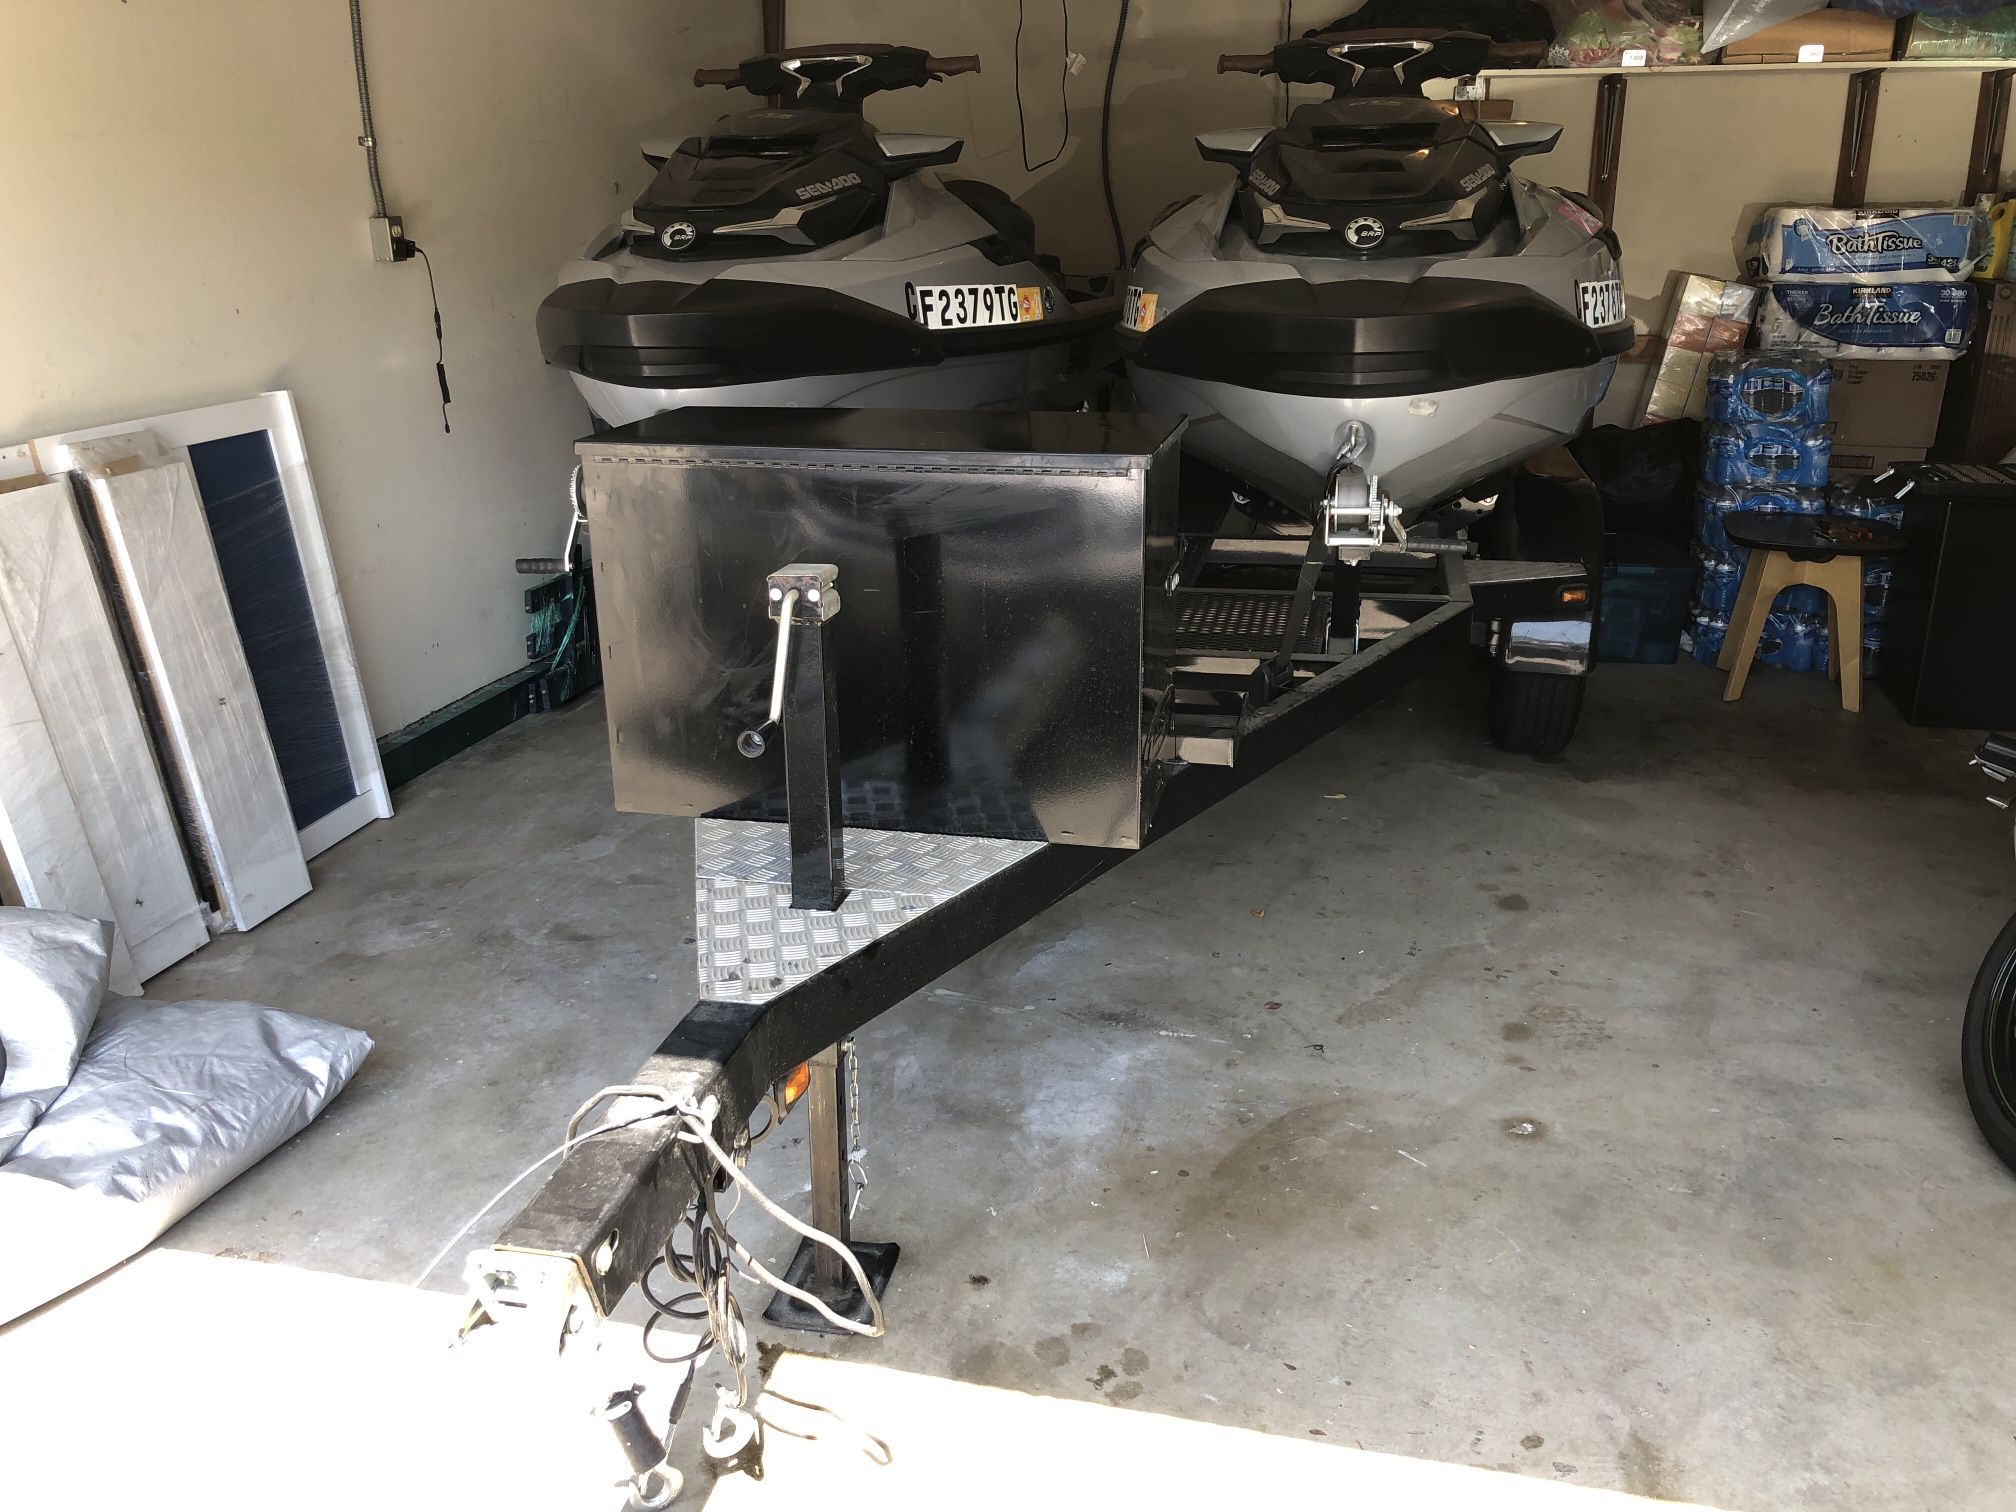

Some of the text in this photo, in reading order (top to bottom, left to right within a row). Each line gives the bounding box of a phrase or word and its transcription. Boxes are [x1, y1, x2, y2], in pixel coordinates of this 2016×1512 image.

[1828, 231, 1923, 254] Bath Tissue
[1852, 287, 1892, 295] KIRKLAND
[904, 281, 1019, 328] CF2379TG
[1814, 302, 1922, 325] Bath Tissue
